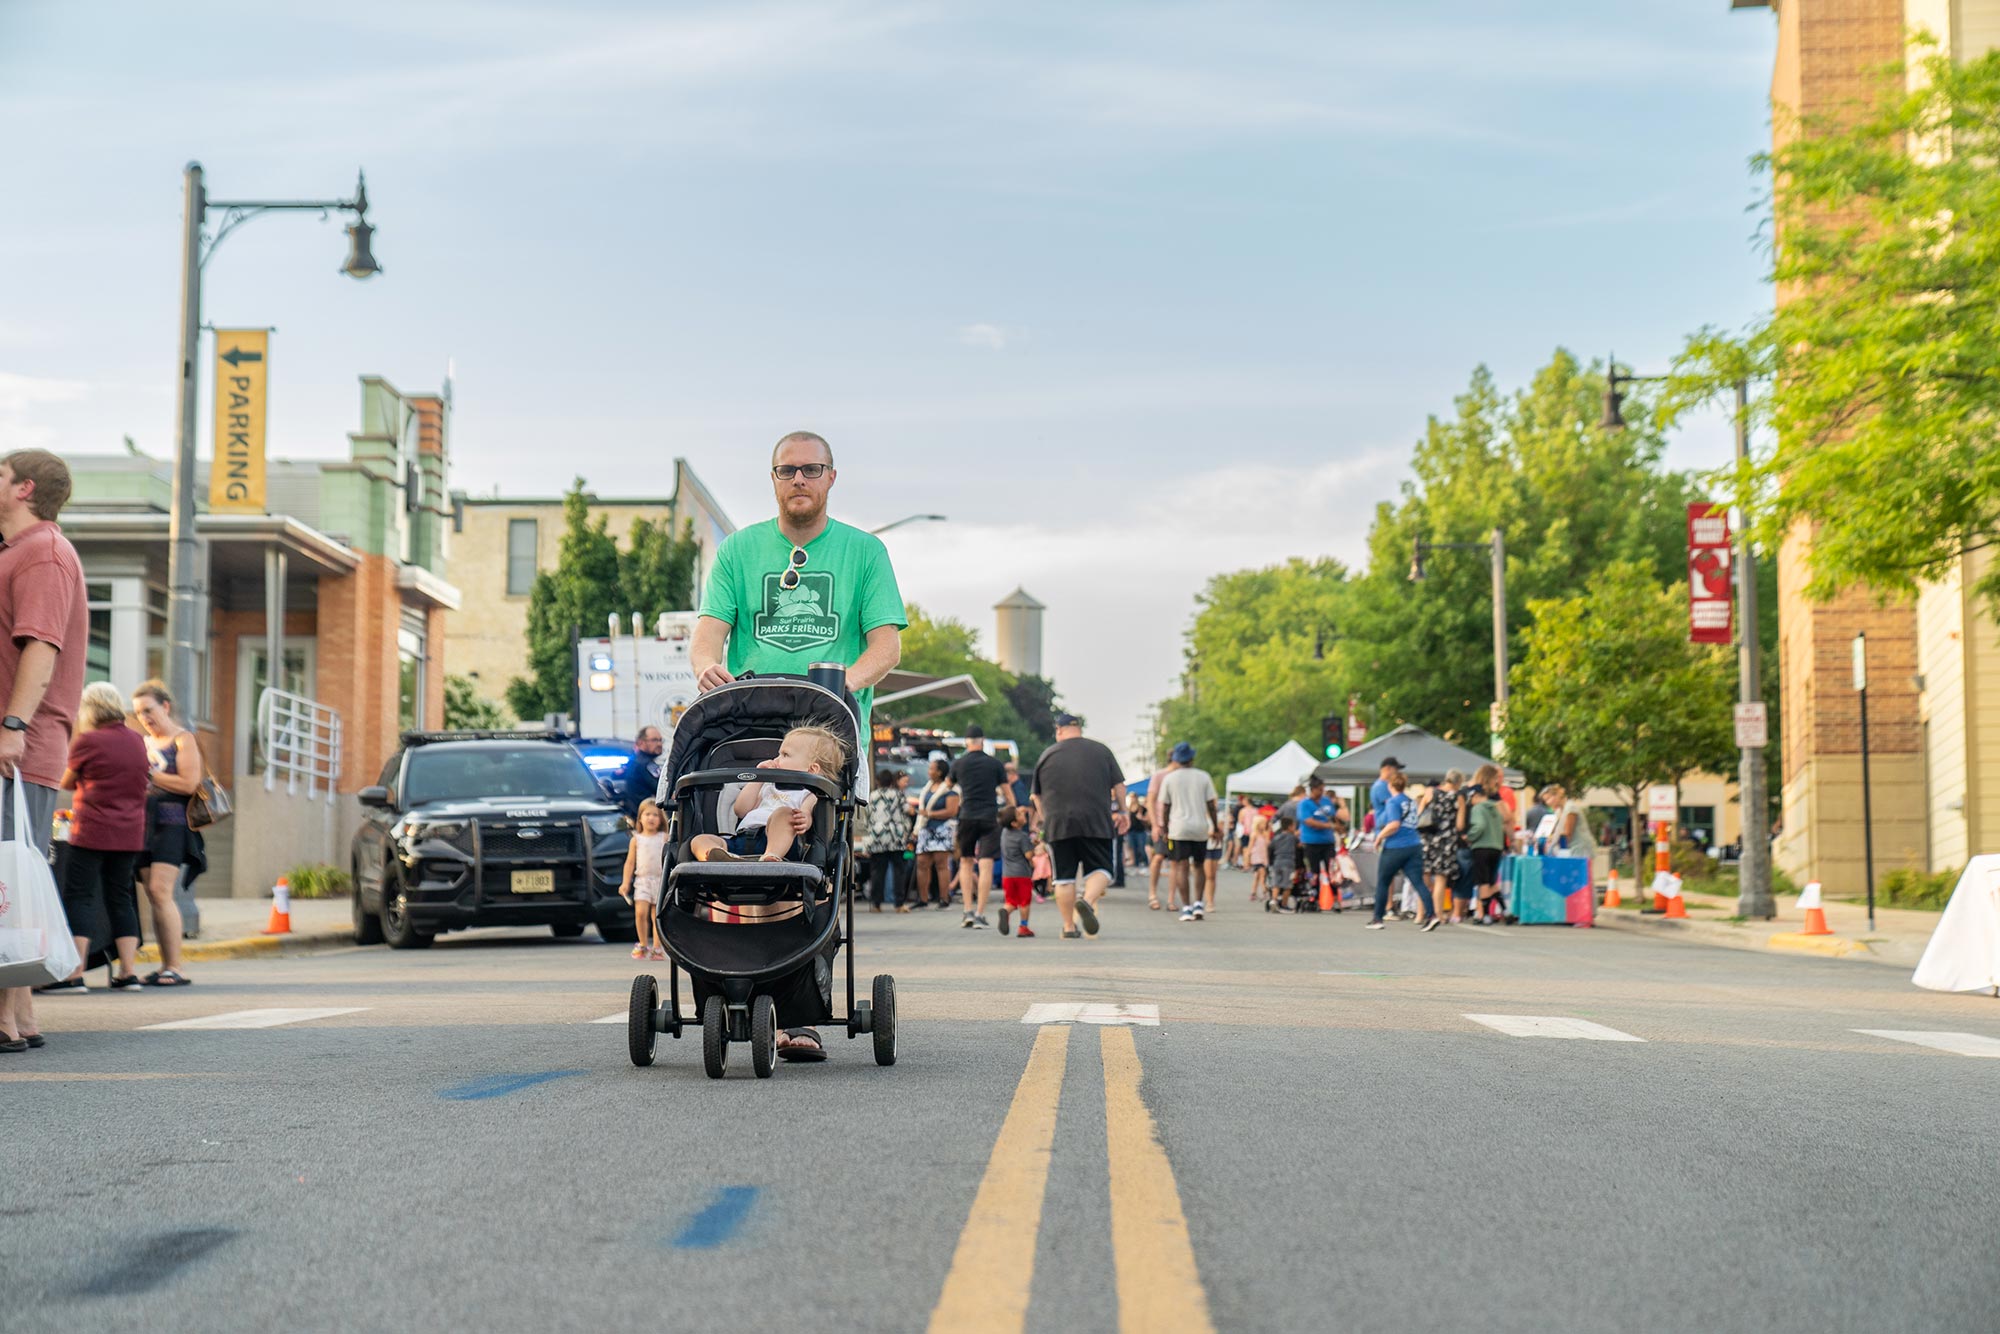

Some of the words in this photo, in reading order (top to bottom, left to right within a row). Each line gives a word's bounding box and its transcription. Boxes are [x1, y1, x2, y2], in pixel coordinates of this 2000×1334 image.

[226, 376, 250, 501] PARKING
[793, 616, 815, 624] Prairie
[760, 624, 790, 634] PARKS
[792, 624, 834, 635] FRIENDS
[644, 671, 693, 681] WISCON
[506, 809, 548, 818] POLICE
